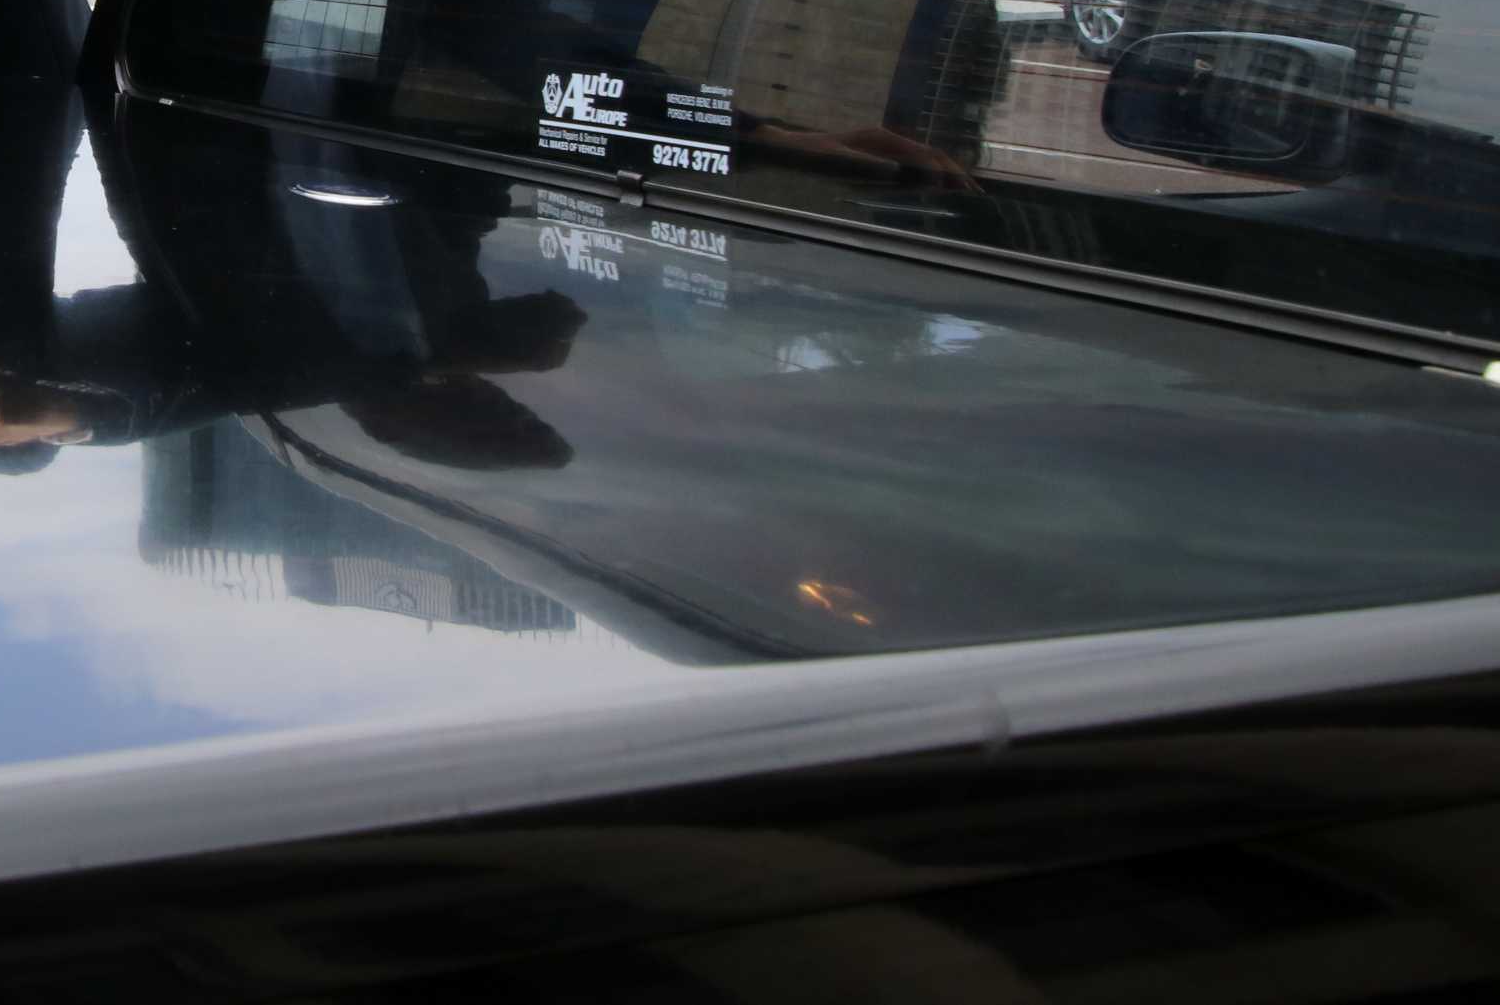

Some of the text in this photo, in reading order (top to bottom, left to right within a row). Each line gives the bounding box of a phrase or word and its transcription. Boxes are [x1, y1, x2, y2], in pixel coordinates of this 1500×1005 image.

[555, 72, 624, 120] Auto
[582, 97, 628, 127] EUROPE
[538, 138, 606, 157] ALL MAKES OF VEHICLES
[652, 143, 730, 176] 9274 3774
